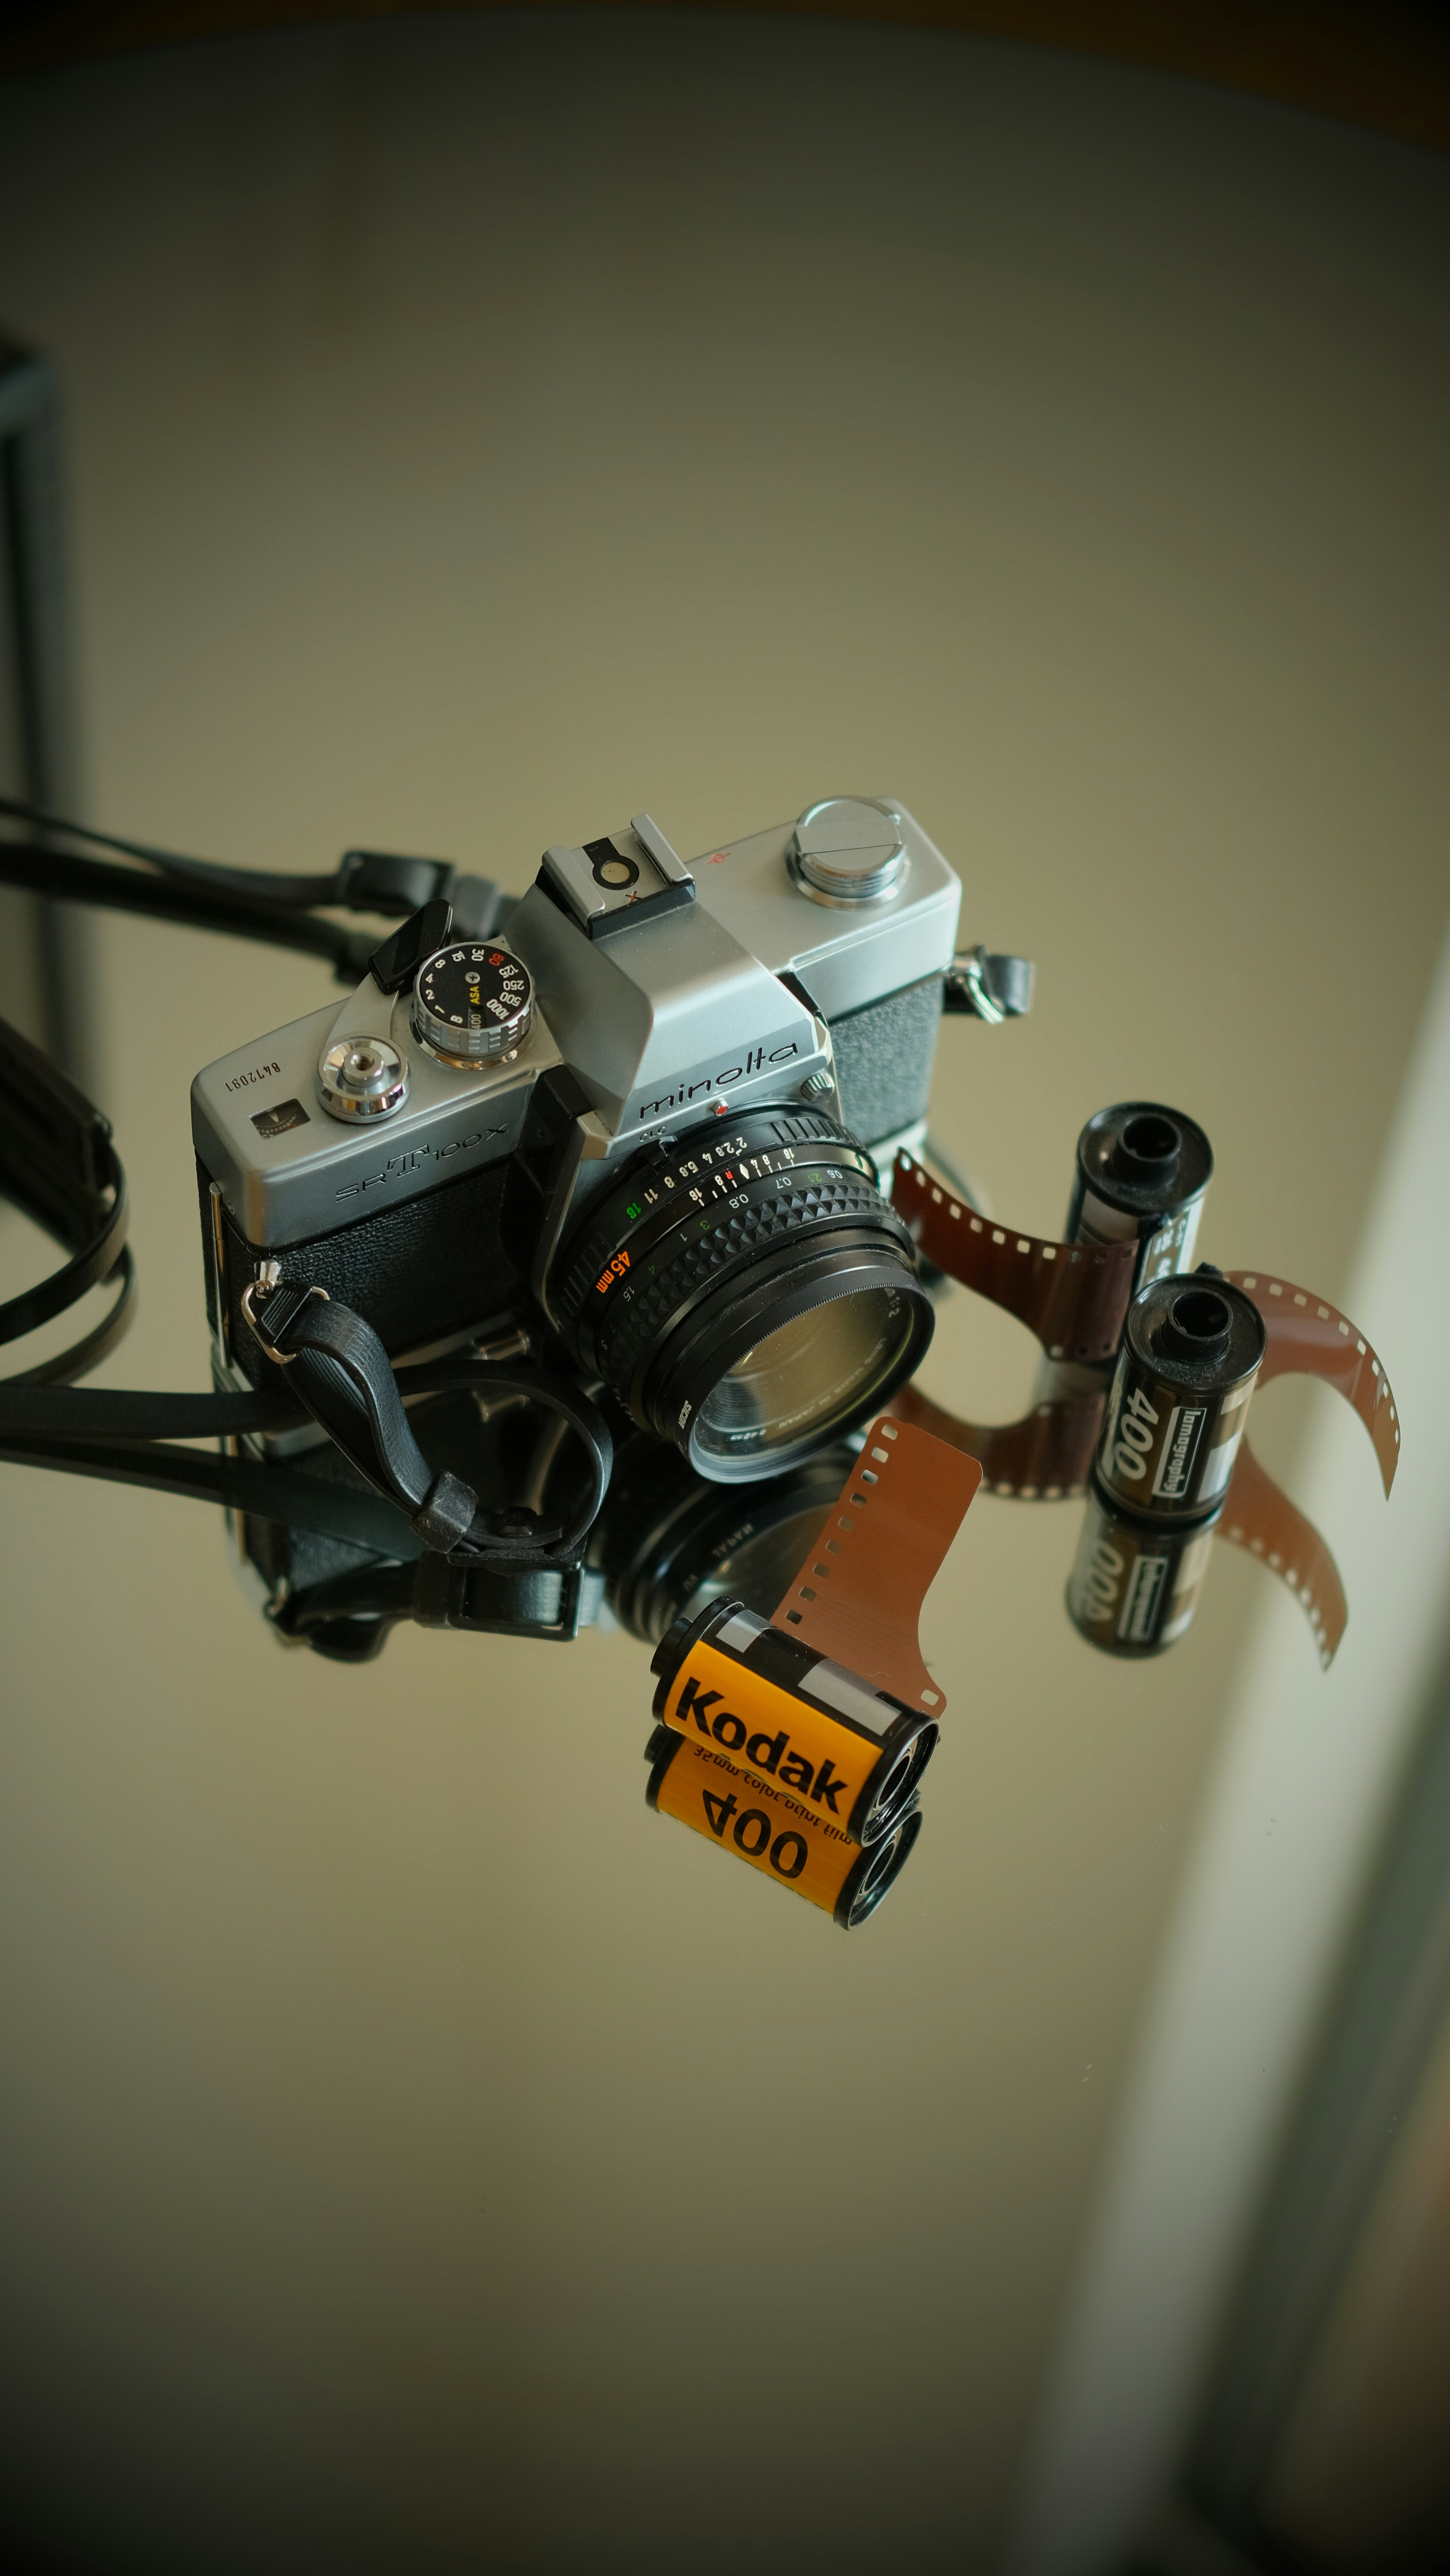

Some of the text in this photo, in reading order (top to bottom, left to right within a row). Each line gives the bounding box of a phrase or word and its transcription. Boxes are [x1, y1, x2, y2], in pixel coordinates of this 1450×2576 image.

[452, 951, 466, 962] 15
[471, 949, 484, 961] 30
[489, 952, 505, 966] 60
[435, 959, 446, 968] 8
[499, 964, 519, 978] 125
[425, 973, 434, 984] 4
[503, 980, 524, 991] 250
[425, 989, 435, 1000] 2
[469, 985, 480, 1004] ASA
[500, 992, 522, 1007] 500
[435, 1005, 445, 1014] 1
[486, 999, 509, 1020] 1000
[450, 1015, 463, 1024] B
[225, 1062, 281, 1092] 8472091
[640, 1043, 798, 1120] minolta
[639, 1126, 666, 1142] CLC
[736, 1136, 747, 1148] 2
[715, 1142, 735, 1157] 2.8
[702, 1153, 713, 1164] 4
[751, 1158, 758, 1170] 4
[763, 1155, 770, 1166] 8
[679, 1161, 699, 1177] 5.6
[827, 1170, 843, 1179] 0.6
[715, 1175, 724, 1186] 8
[725, 1171, 733, 1180] R
[664, 1177, 675, 1189] 8
[776, 1177, 791, 1189] 0.7
[644, 1189, 658, 1204] 11
[689, 1188, 702, 1201] 16
[729, 1194, 749, 1209] 0.8
[627, 1203, 641, 1219] 16
[700, 1220, 710, 1230] 3
[680, 1234, 687, 1242] 1
[623, 1286, 635, 1302] 1.5
[778, 1406, 815, 1428] JAPAN
[1115, 1388, 1159, 1480] 400
[1163, 1410, 1201, 1492] lomography
[675, 1676, 848, 1815] Kodak
